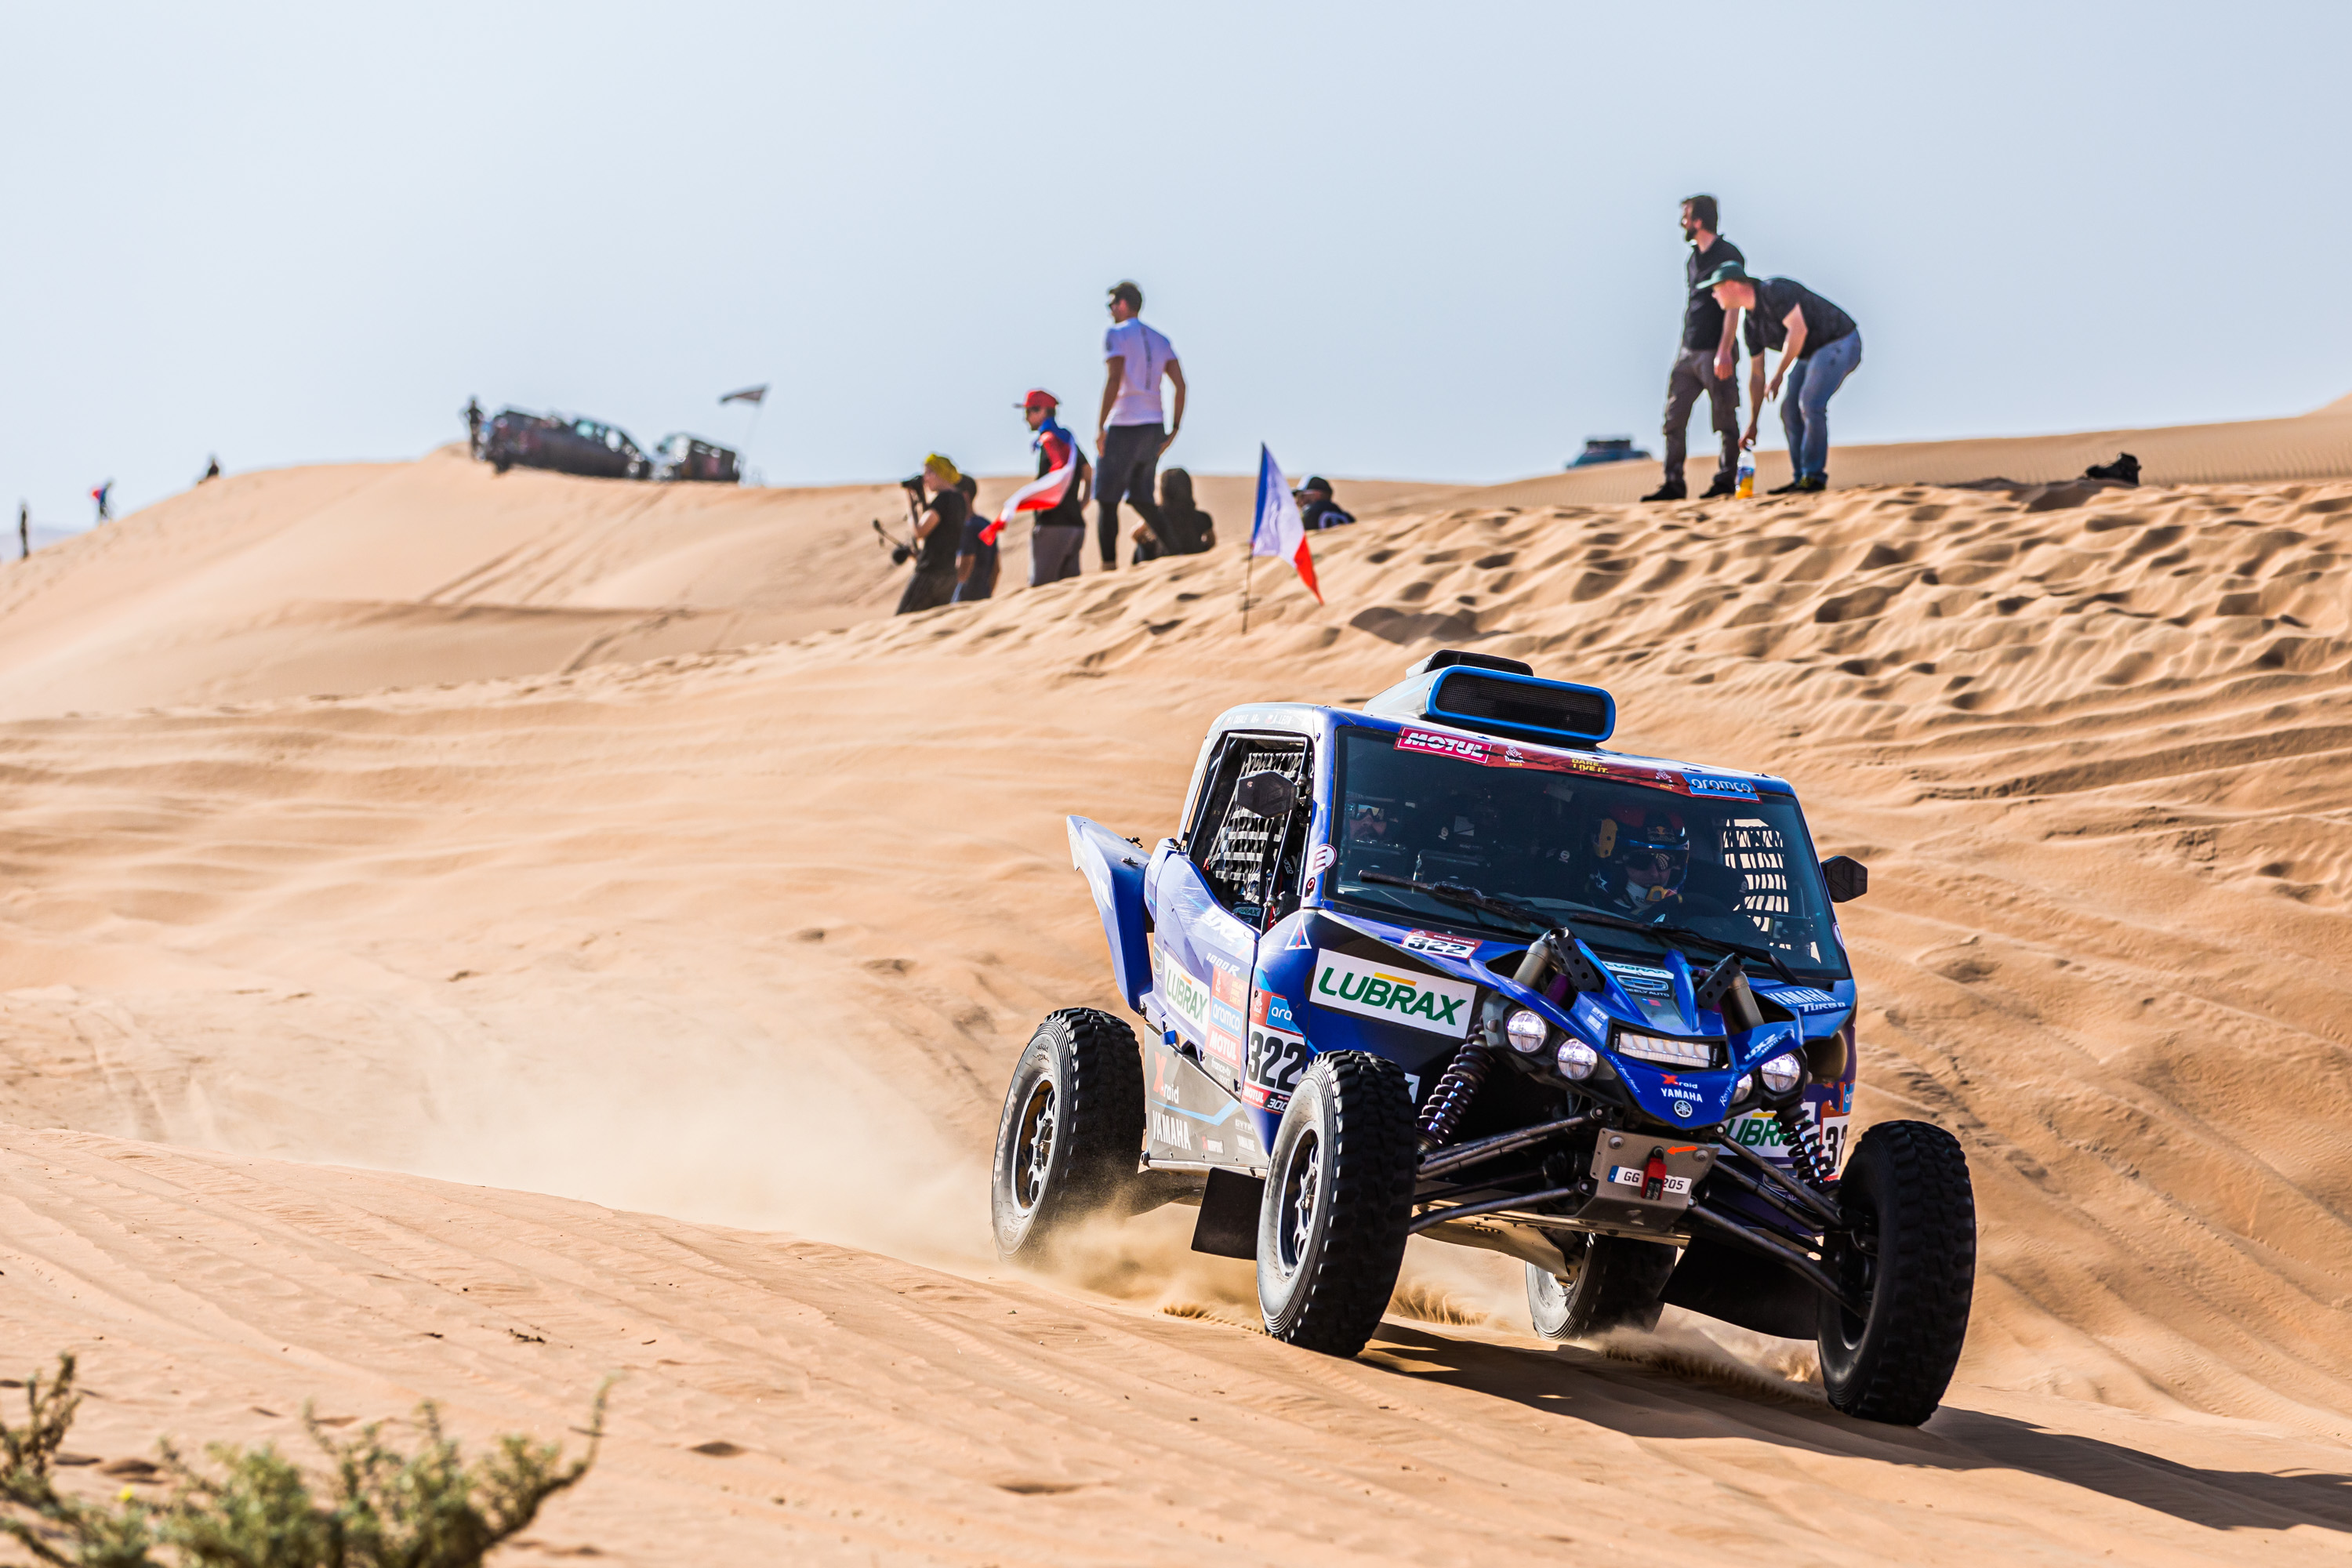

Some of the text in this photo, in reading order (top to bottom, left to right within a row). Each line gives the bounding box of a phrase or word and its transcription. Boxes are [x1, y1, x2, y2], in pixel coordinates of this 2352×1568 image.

[1405, 732, 1485, 758] MOTUL
[1571, 759, 1602, 768] DARE.
[1691, 779, 1751, 793] aramco
[1407, 937, 1467, 956] 322
[1166, 969, 1208, 1024] LUBRAX
[1318, 967, 1468, 1026] LUBRAX
[1763, 989, 1836, 1005] YAMAHA
[1212, 1004, 1240, 1030] aramco
[1209, 1030, 1237, 1061] MOTUL
[1247, 1031, 1305, 1092] 322
[1219, 1073, 1231, 1088] sport
[1243, 1084, 1264, 1104] MOTUL
[1661, 1087, 1703, 1103] YAMAHA
[1152, 1109, 1192, 1151] YAMAHA
[1624, 1171, 1641, 1183] GG
